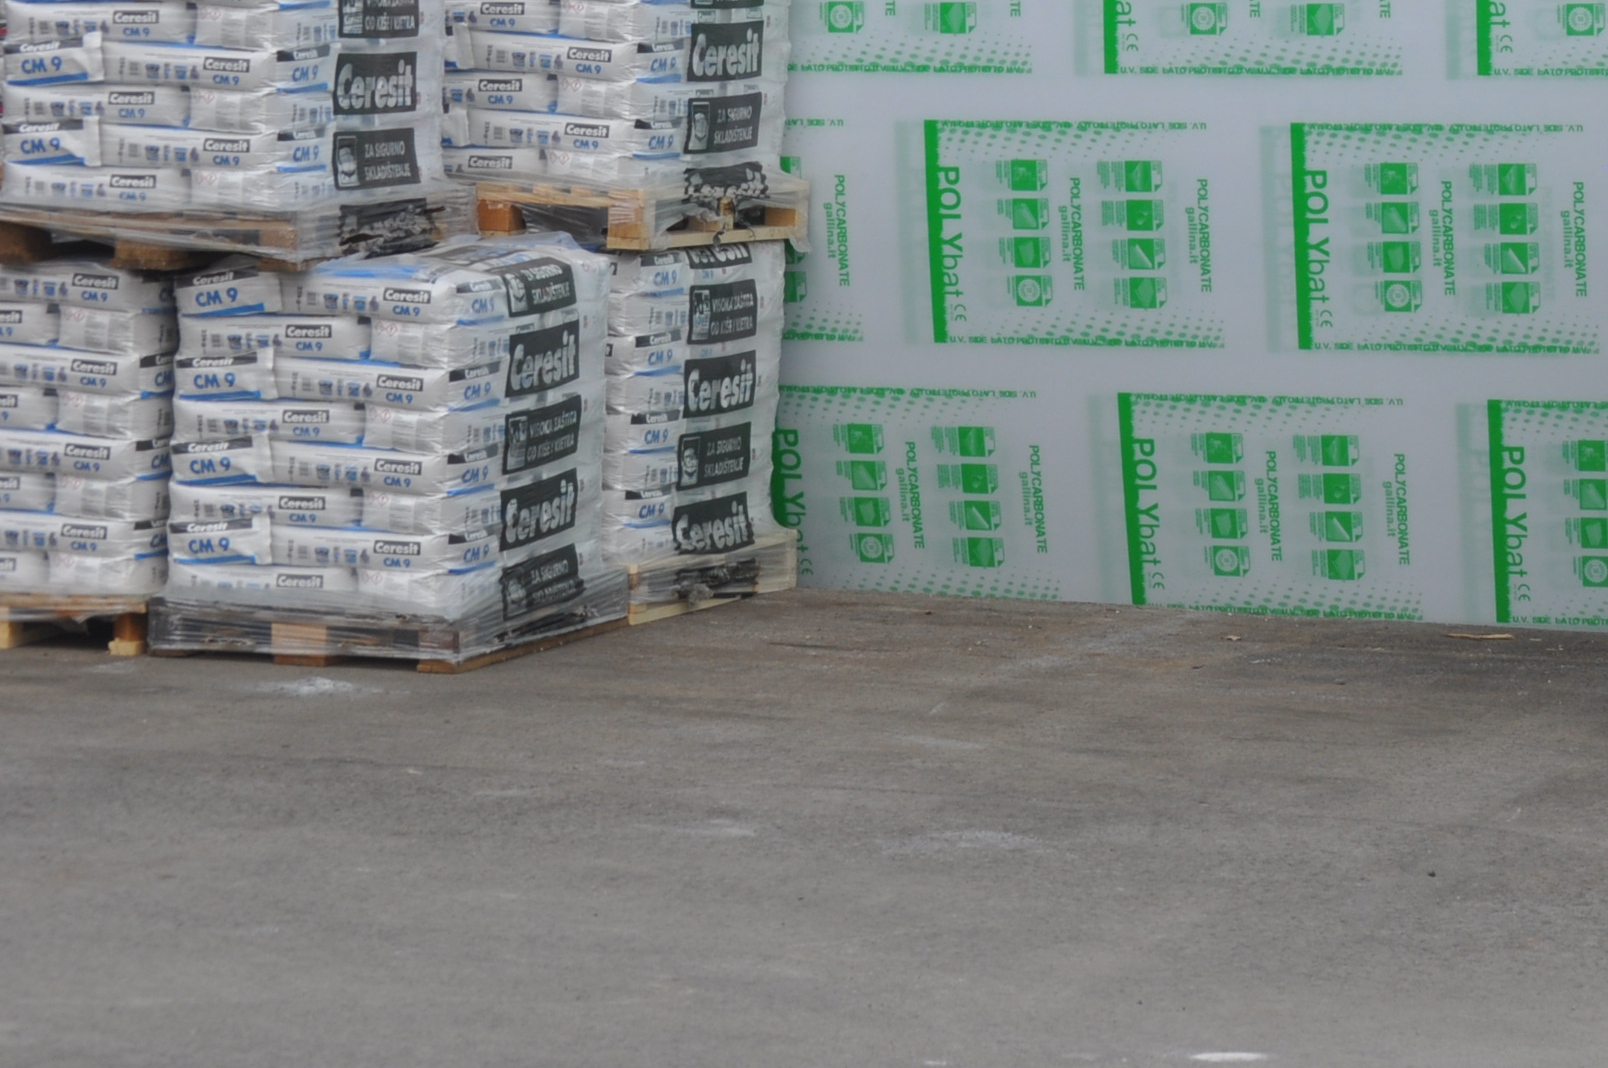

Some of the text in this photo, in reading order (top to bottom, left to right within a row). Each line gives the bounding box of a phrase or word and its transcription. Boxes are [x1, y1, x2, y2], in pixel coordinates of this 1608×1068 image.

[692, 30, 759, 77] Ceresit
[338, 61, 413, 110] Ceresit
[834, 174, 850, 287] POLYCARBONATE
[1070, 178, 1085, 290] POLYCARBONATE
[1197, 179, 1212, 292] POLYCARBONATE
[1441, 181, 1455, 296] POLYCARBONATE
[1573, 181, 1587, 297] POLYCARBONATE
[74, 276, 117, 288] Ceresit
[193, 272, 234, 285] Ceresit
[196, 287, 238, 306] CM 9
[384, 290, 429, 303] Ceresit
[511, 332, 577, 390] Ceresit
[687, 365, 753, 411] Ceresit
[190, 457, 231, 473] CM 9
[505, 480, 574, 541] Ceresit
[906, 441, 925, 549] POLYCARBONATE
[1029, 445, 1048, 553] POLYCARBONATE
[1265, 451, 1282, 562] POLYCARBONATE
[1394, 453, 1410, 565] POLYCARBONATE
[676, 505, 749, 550] Ceresit
